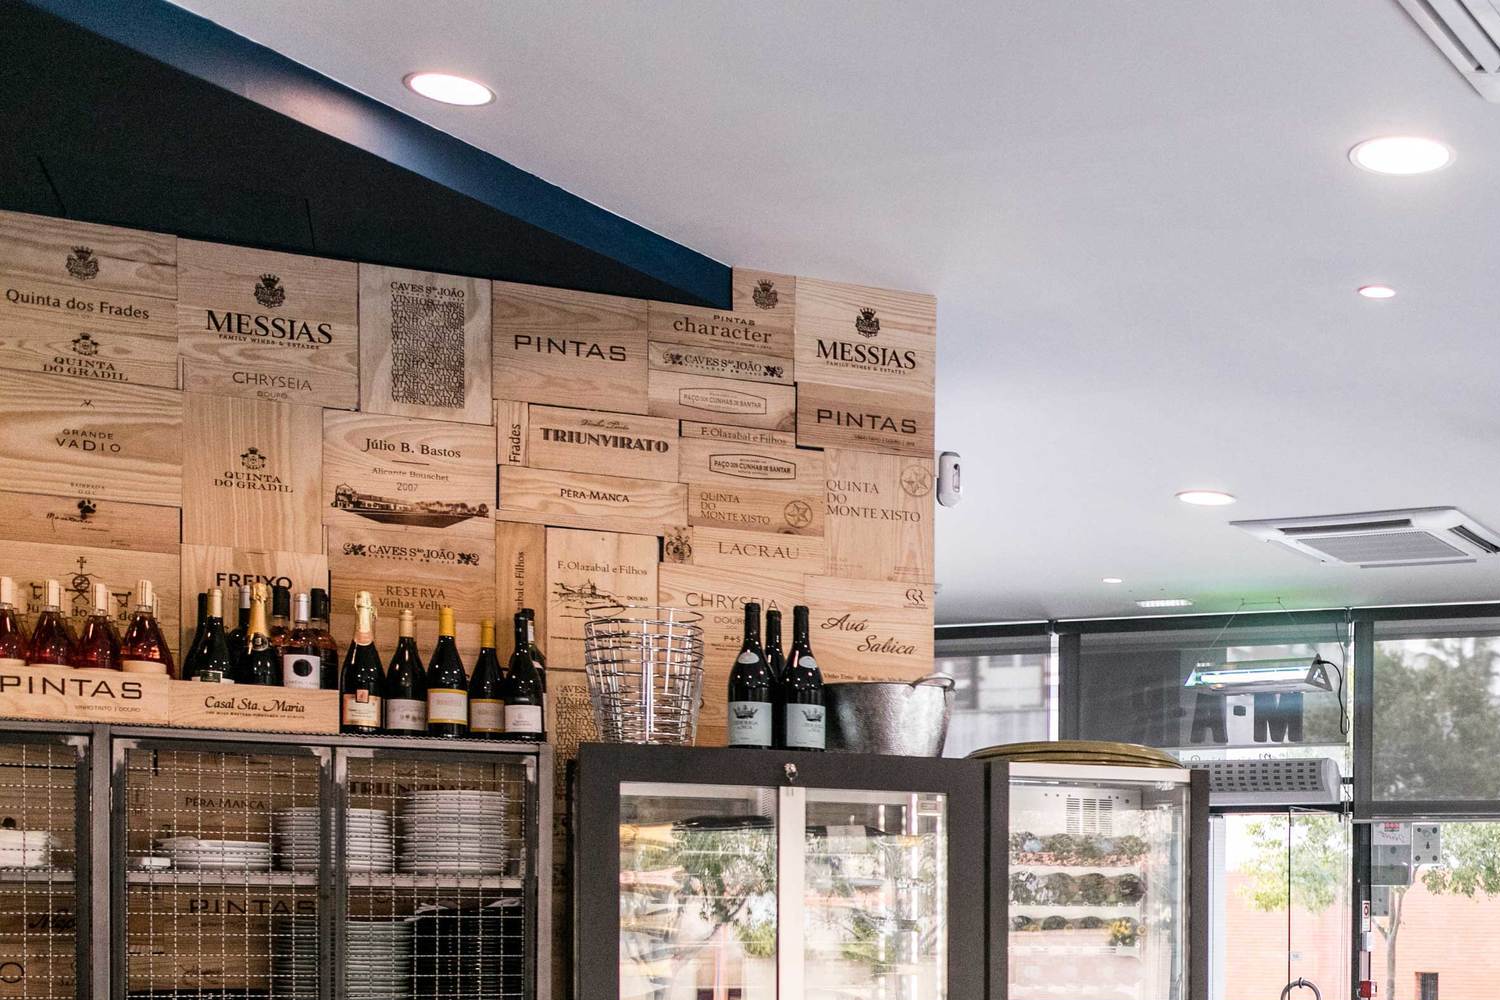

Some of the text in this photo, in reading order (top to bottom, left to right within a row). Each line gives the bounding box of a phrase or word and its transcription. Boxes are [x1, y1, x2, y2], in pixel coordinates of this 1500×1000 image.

[391, 281, 424, 293] CAVES
[440, 287, 464, 298] JOÃO
[6, 289, 149, 319] Quinta dos Frades
[205, 309, 333, 345] MESSIAS
[713, 314, 755, 326] PINTAS
[218, 334, 248, 342] FAMILY
[673, 317, 772, 343] character
[514, 334, 627, 362] PINTAS
[816, 339, 916, 370] MESSIAS
[53, 356, 116, 371] QUINTA
[684, 354, 720, 368] CAVES
[733, 360, 762, 372] JOÃO
[43, 364, 128, 381] DO GRADIL
[232, 371, 313, 391] CHRYSEIA
[816, 408, 917, 434] PINTAS
[62, 428, 114, 440] GRANDE
[539, 427, 669, 453] TRIUNVIRATO
[711, 428, 751, 441] Olazabal
[760, 434, 787, 445] Filhos
[55, 437, 121, 453] VADIO
[361, 438, 461, 459] Júlio B. Bastos
[509, 423, 521, 464] Frades
[409, 471, 450, 482] Bouschet
[739, 463, 763, 472] CUNHAS
[769, 466, 792, 474] SANTAR
[224, 471, 282, 484] QUINTA
[214, 479, 294, 494] DO GRADIL
[396, 482, 419, 492] 2007
[826, 480, 880, 495] QUINTA
[700, 491, 740, 504] QUINTA
[701, 501, 717, 510] DO
[827, 492, 848, 504] DO
[700, 510, 771, 525] MONTE XISTO
[825, 504, 921, 522] MONTE XISTO
[368, 544, 408, 557] CAVES
[423, 547, 455, 561] JOÃO
[718, 541, 800, 560] LACRAU
[515, 551, 525, 579] Filhos
[557, 560, 648, 576] F. Olazabal e Filhos
[385, 585, 446, 599] RESERVA
[517, 580, 524, 588] e
[379, 598, 415, 609] Vinhas
[820, 613, 870, 632] Avó
[857, 634, 918, 655] Sabica
[0, 675, 143, 700] PINTAS
[205, 696, 305, 713] Casal Sta. Maria
[189, 899, 317, 915] PINTAS
